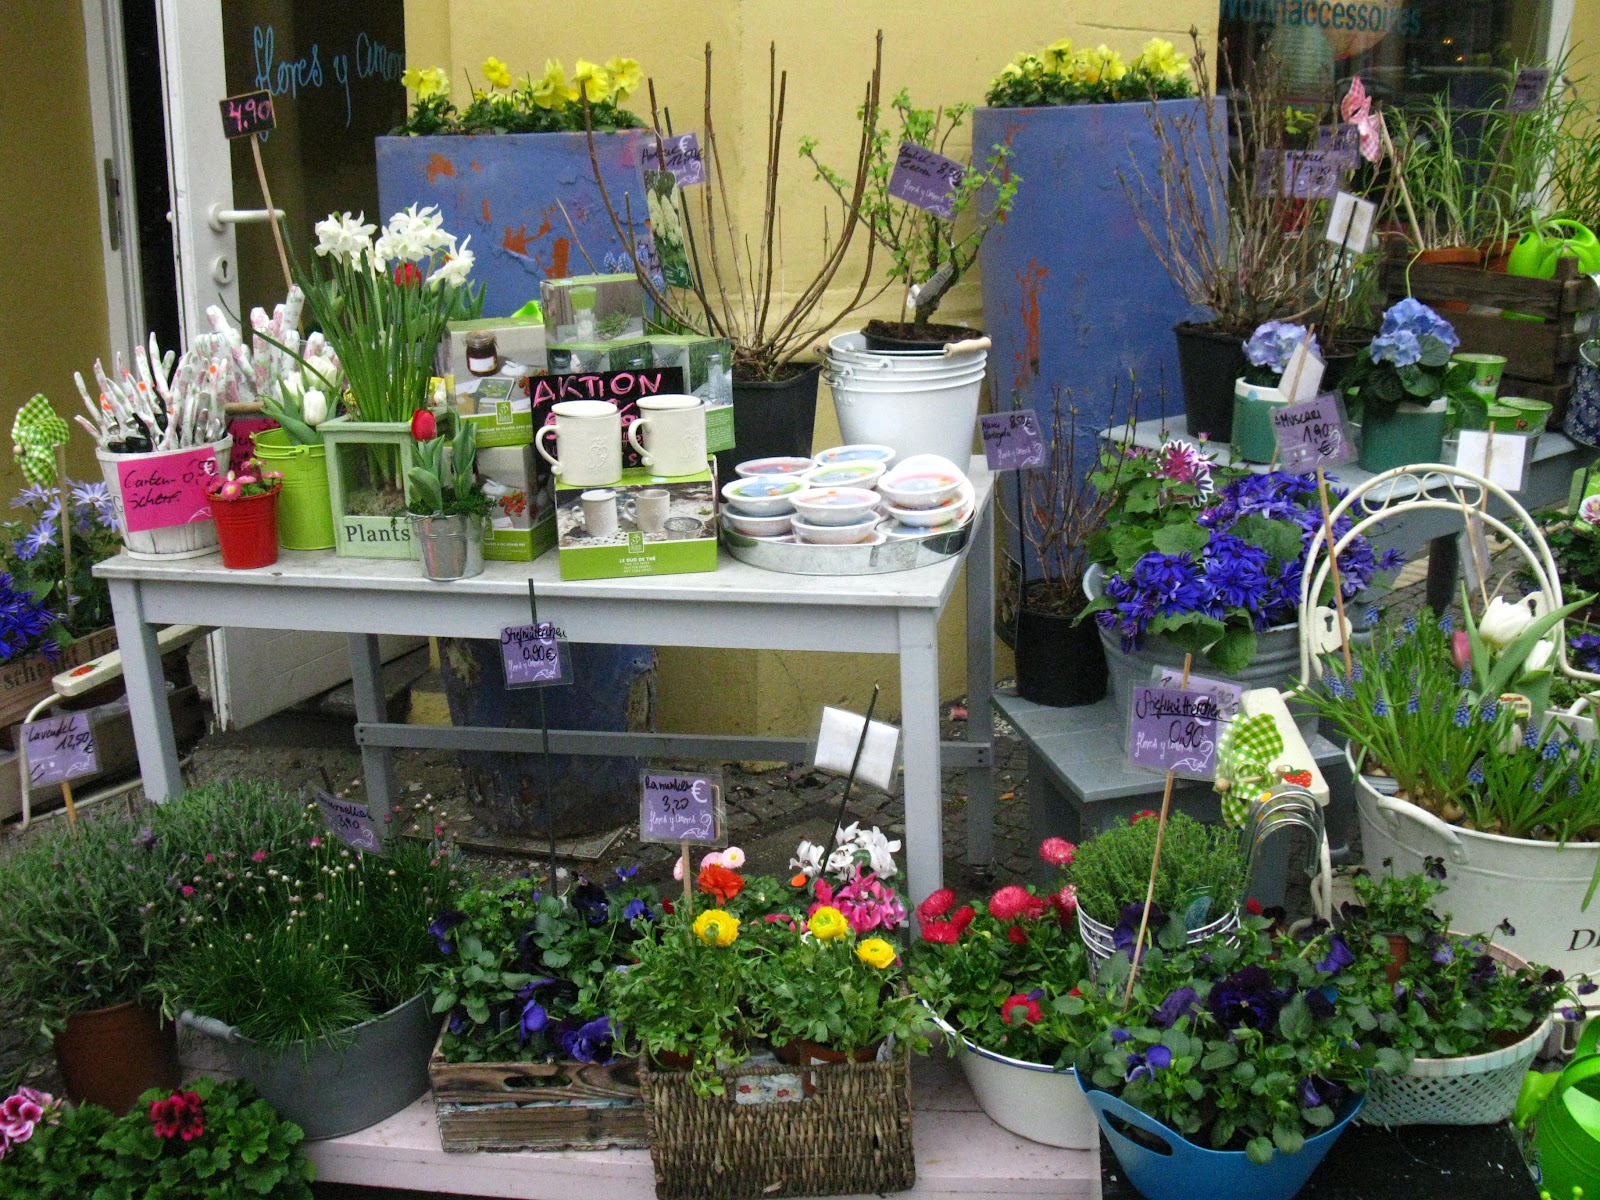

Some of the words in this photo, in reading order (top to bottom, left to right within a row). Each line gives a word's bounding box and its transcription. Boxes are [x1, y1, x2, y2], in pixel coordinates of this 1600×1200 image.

[333, 54, 352, 128] y
[344, 524, 411, 542] Plants
[1565, 929, 1600, 951] D
